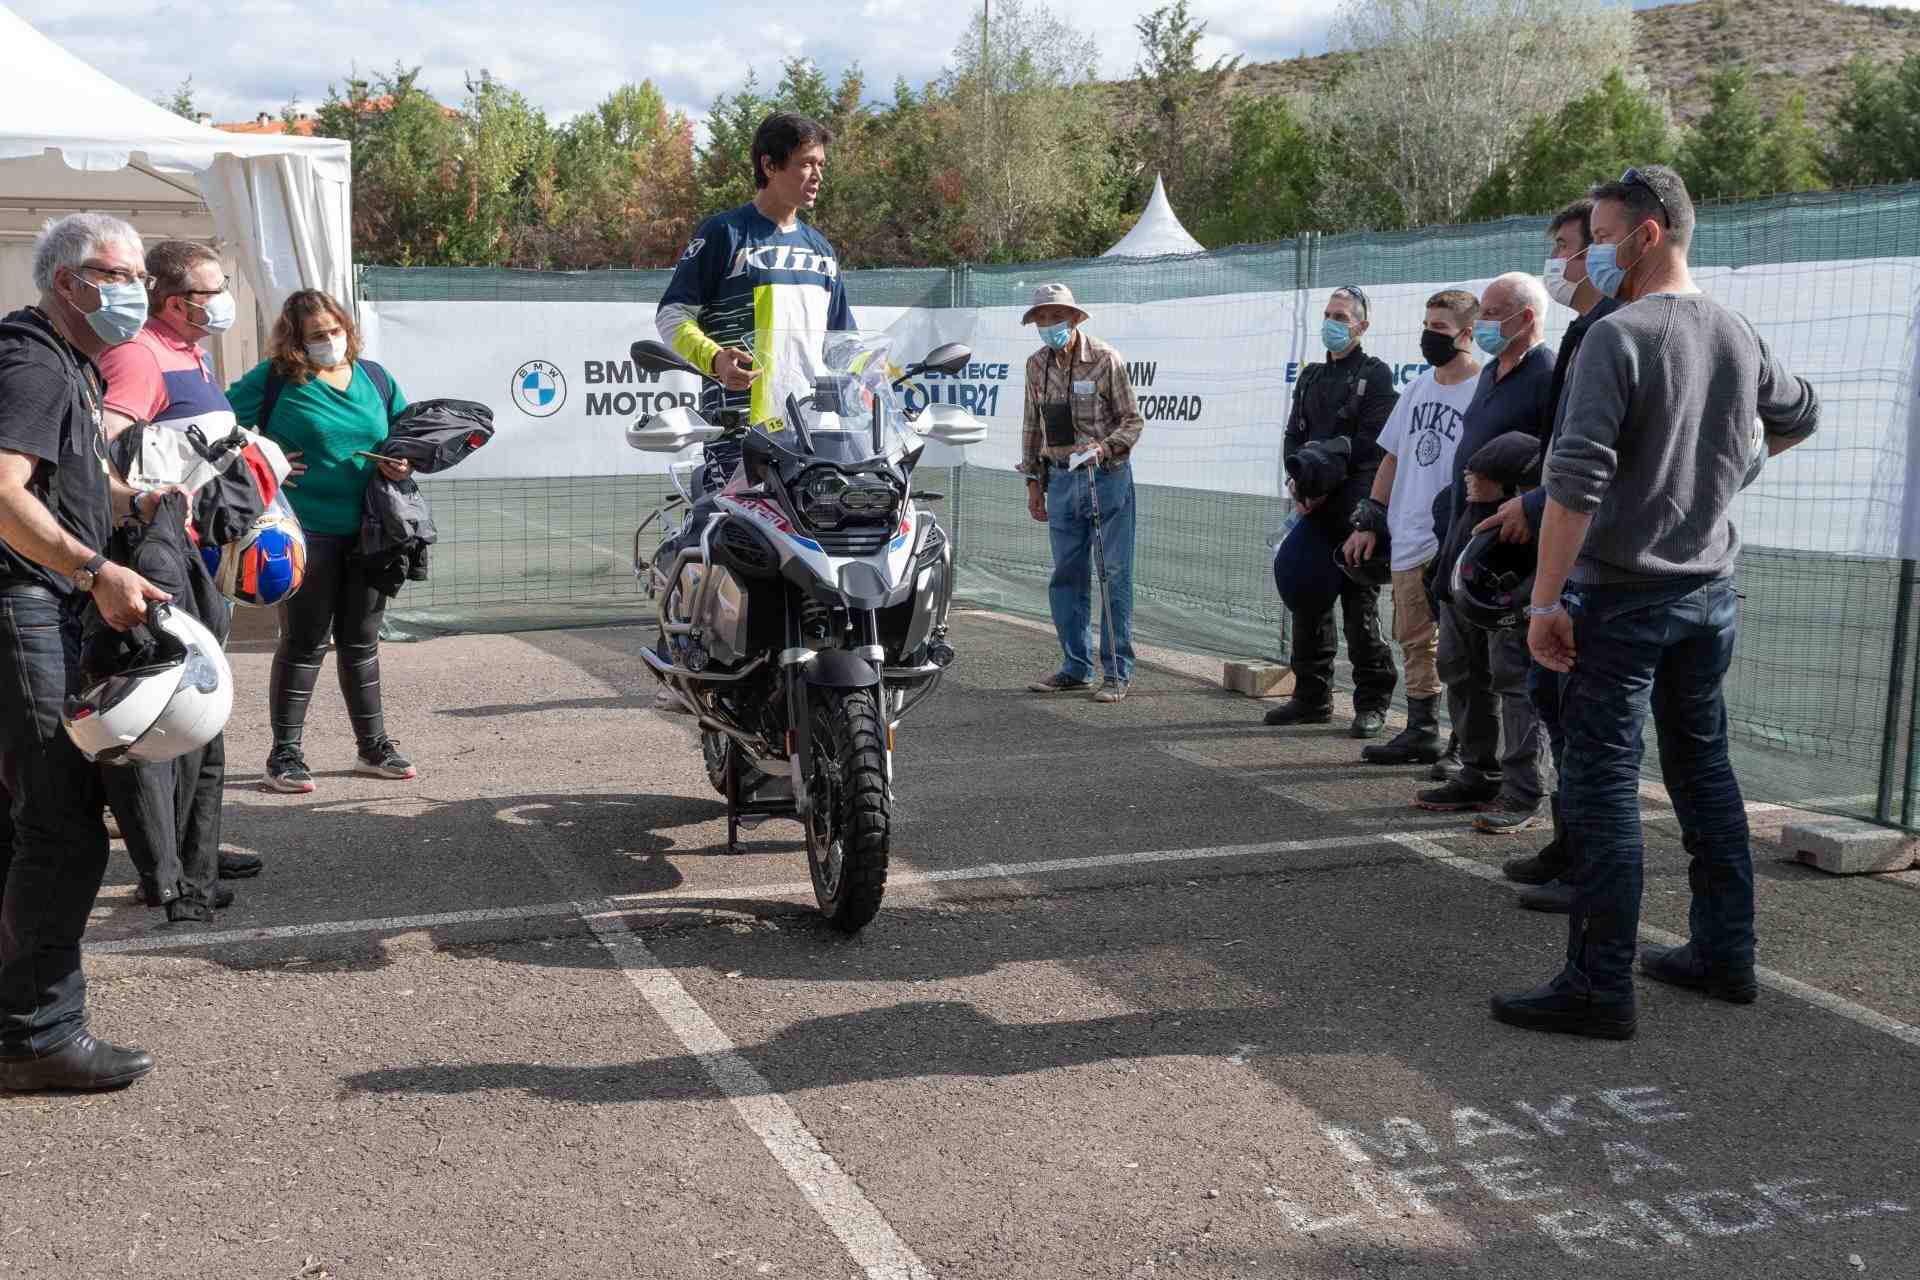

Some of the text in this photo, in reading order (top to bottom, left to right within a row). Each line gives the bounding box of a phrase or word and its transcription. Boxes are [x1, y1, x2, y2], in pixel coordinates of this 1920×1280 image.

[518, 363, 560, 378] BMW
[1126, 361, 1157, 387] MW
[585, 392, 703, 417] MOTOR
[1137, 395, 1202, 421] TORRAD
[768, 418, 784, 430] 15
[1409, 402, 1464, 442] NIKE
